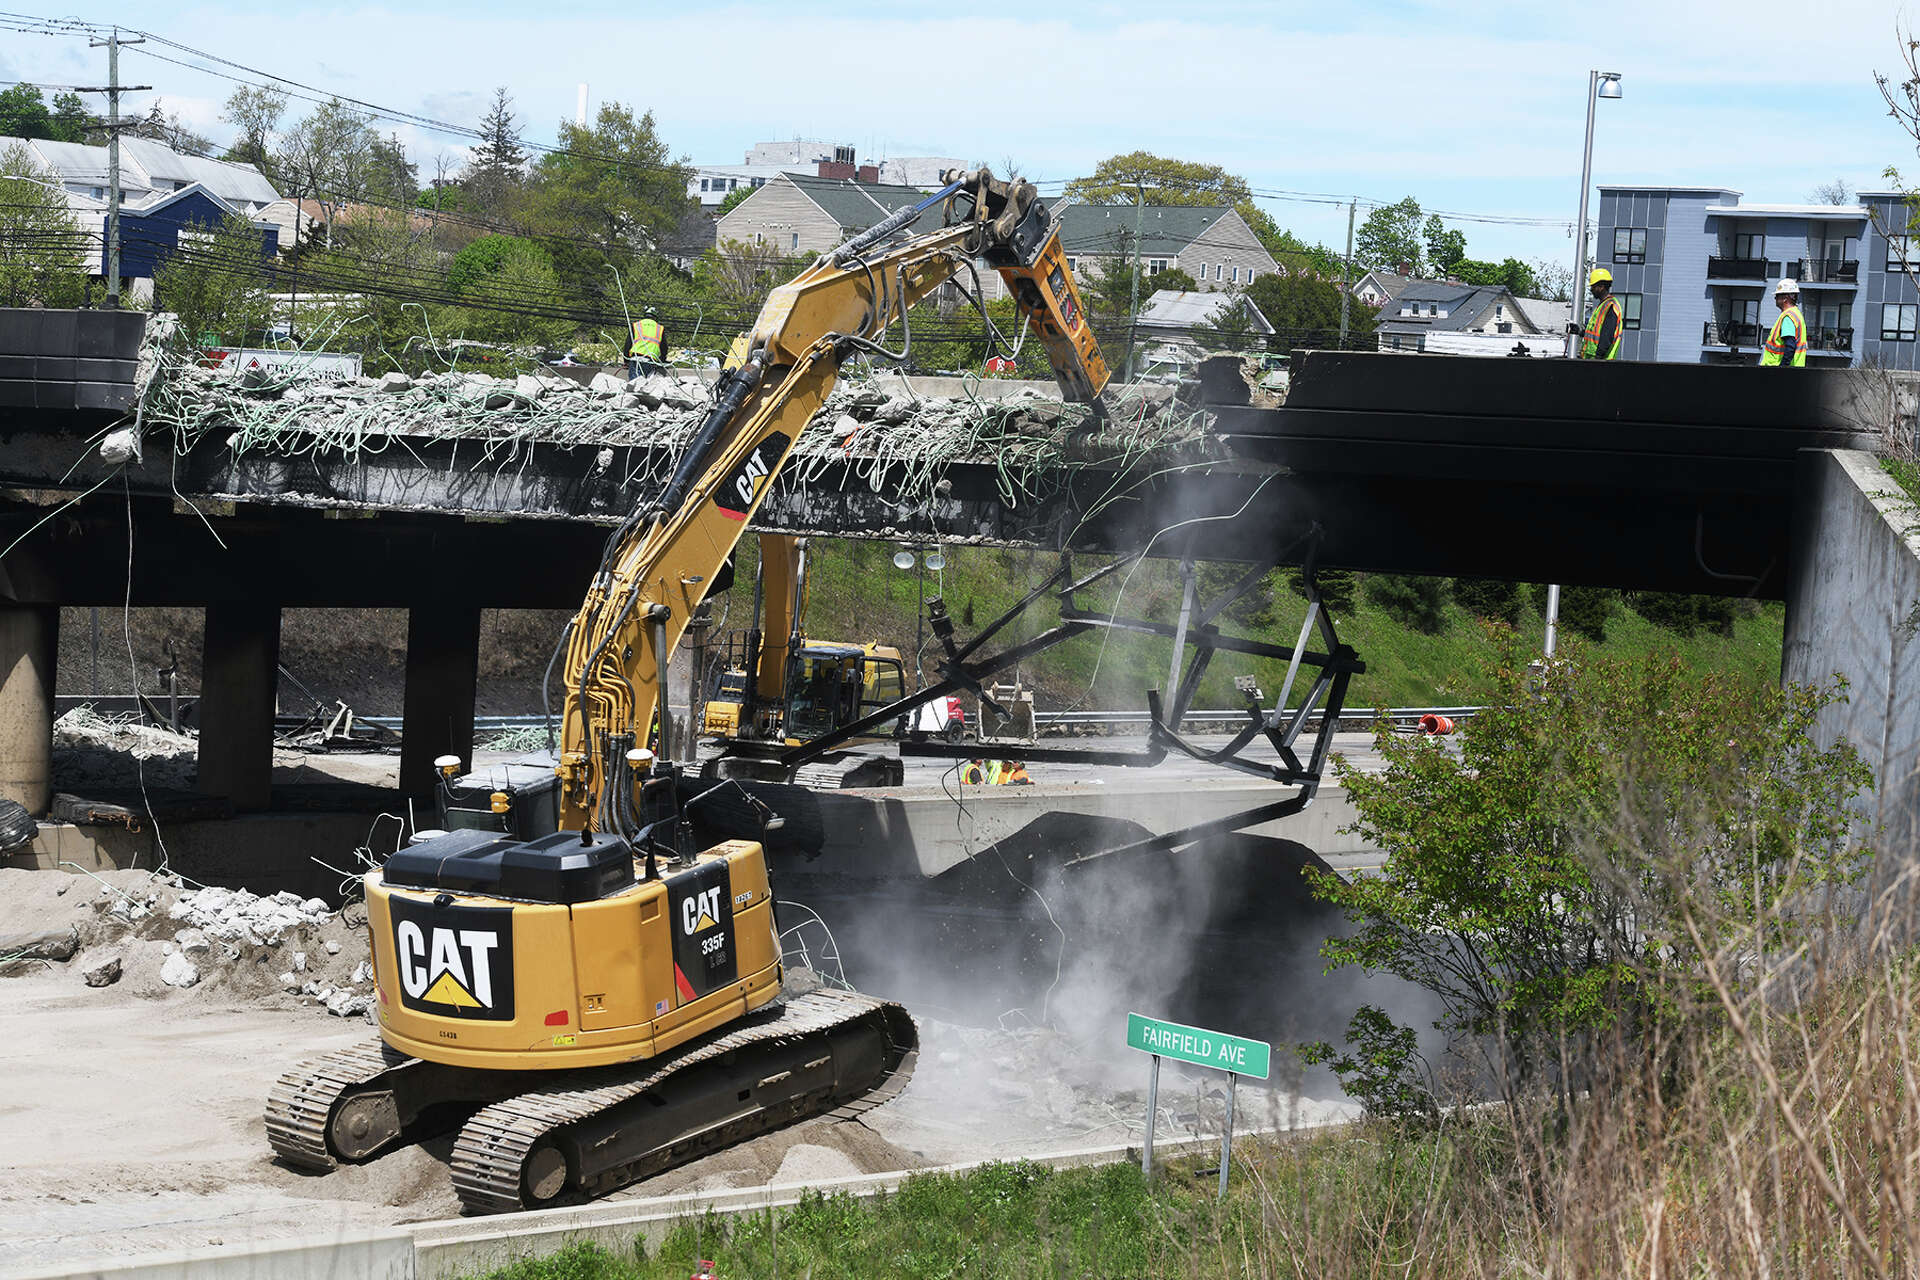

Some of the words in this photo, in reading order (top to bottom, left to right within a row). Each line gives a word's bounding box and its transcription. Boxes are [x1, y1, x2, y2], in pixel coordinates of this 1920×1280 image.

[736, 447, 769, 504] CAT
[682, 886, 721, 935] CAT
[398, 920, 498, 1008] CAT
[701, 932, 725, 955] 335F
[1143, 1026, 1212, 1057] FAIRFIELD
[1218, 1043, 1246, 1065] AVE
